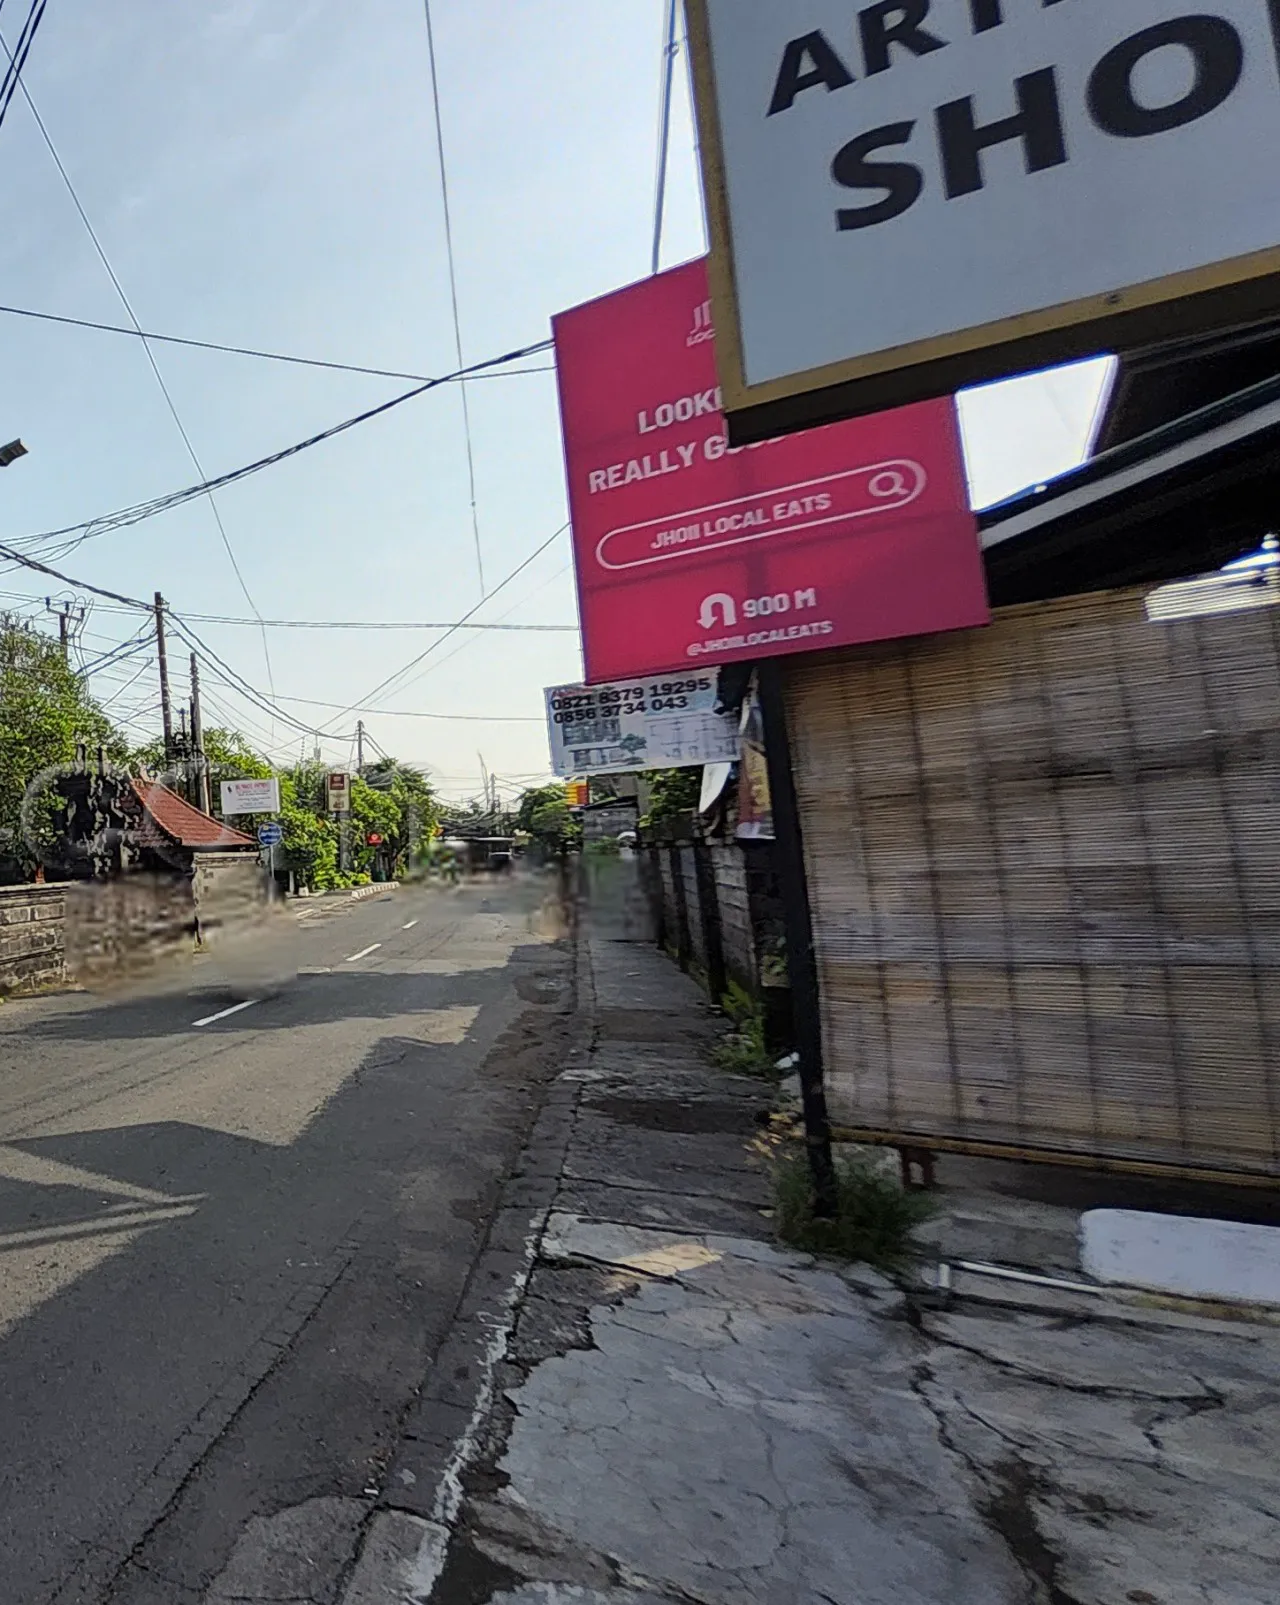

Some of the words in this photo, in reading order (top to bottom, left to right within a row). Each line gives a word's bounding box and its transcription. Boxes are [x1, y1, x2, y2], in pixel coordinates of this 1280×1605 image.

[830, 0, 1280, 232] SHO
[588, 442, 696, 494] REALLY
[704, 508, 771, 537] LOCAL
[773, 493, 832, 521] EATS
[742, 593, 791, 618] 900
[794, 588, 817, 610] M
[551, 693, 595, 711] 0821
[599, 687, 644, 705] 8379
[650, 678, 712, 698] 19295
[601, 701, 648, 717] 3734
[651, 696, 689, 711] 043
